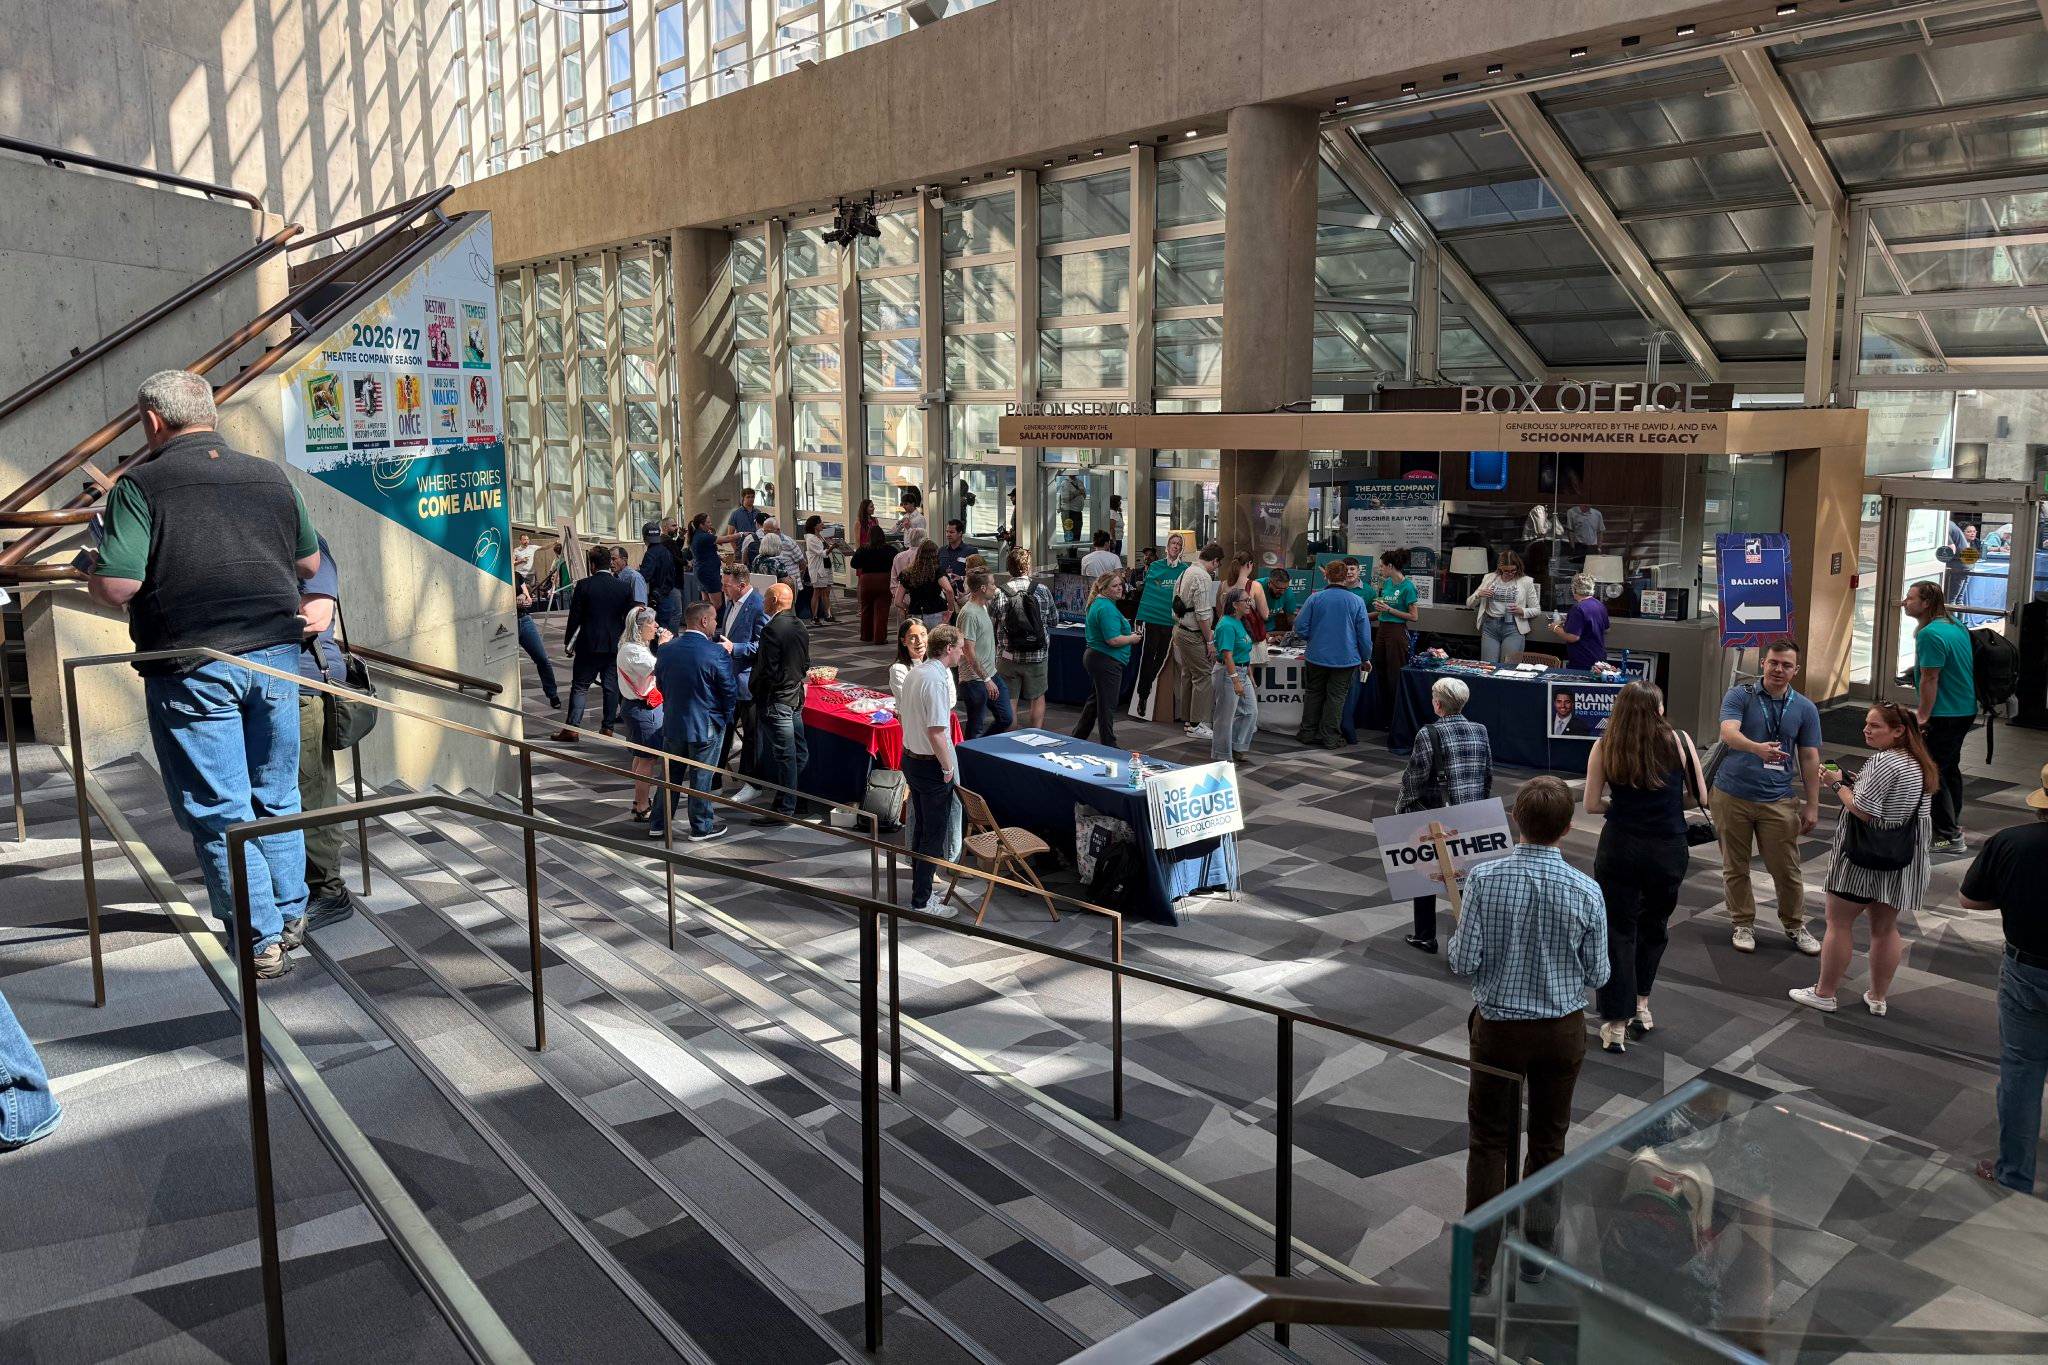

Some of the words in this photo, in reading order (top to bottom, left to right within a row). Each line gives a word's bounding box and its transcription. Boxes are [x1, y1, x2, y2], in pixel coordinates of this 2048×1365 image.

[425, 299, 446, 314] DESTINY
[465, 304, 486, 320] TEMPEST
[352, 323, 420, 350] 2026/27
[322, 351, 357, 362] THEATRE
[359, 353, 394, 364] COMPANY
[395, 356, 422, 365] SEASON
[432, 389, 459, 405] WALKED
[1460, 384, 1542, 414] BOX
[1556, 381, 1711, 414] OFFICE
[1005, 402, 1065, 416] PATRON
[1071, 402, 1152, 416] SERVICES
[398, 413, 422, 435] ONCE
[1505, 422, 1558, 430] GENEROUSLY
[1560, 422, 1609, 430] SUPPORTED
[1611, 422, 1622, 430] BY
[1623, 422, 1640, 430] THE
[1641, 422, 1669, 430] DAVID
[1678, 423, 1698, 431] AND
[1701, 423, 1718, 431] EVA
[1019, 432, 1048, 440] SALAH
[1051, 432, 1113, 440] FOUNDATION
[1520, 432, 1634, 443] SCHOONMAKER
[1639, 433, 1699, 444] LEGACY
[416, 473, 458, 493] WHERE
[460, 469, 501, 488] STORIES
[1393, 484, 1436, 492] COMPANY
[418, 493, 461, 519] COME
[463, 488, 502, 512] ALIVE
[1394, 492, 1435, 501] SEASON
[1731, 578, 1779, 586] BALLROOM
[1164, 786, 1187, 805] JOE
[1165, 790, 1236, 826] NEGUSE
[1175, 825, 1191, 838] FOR
[1190, 814, 1232, 833] COLORADO
